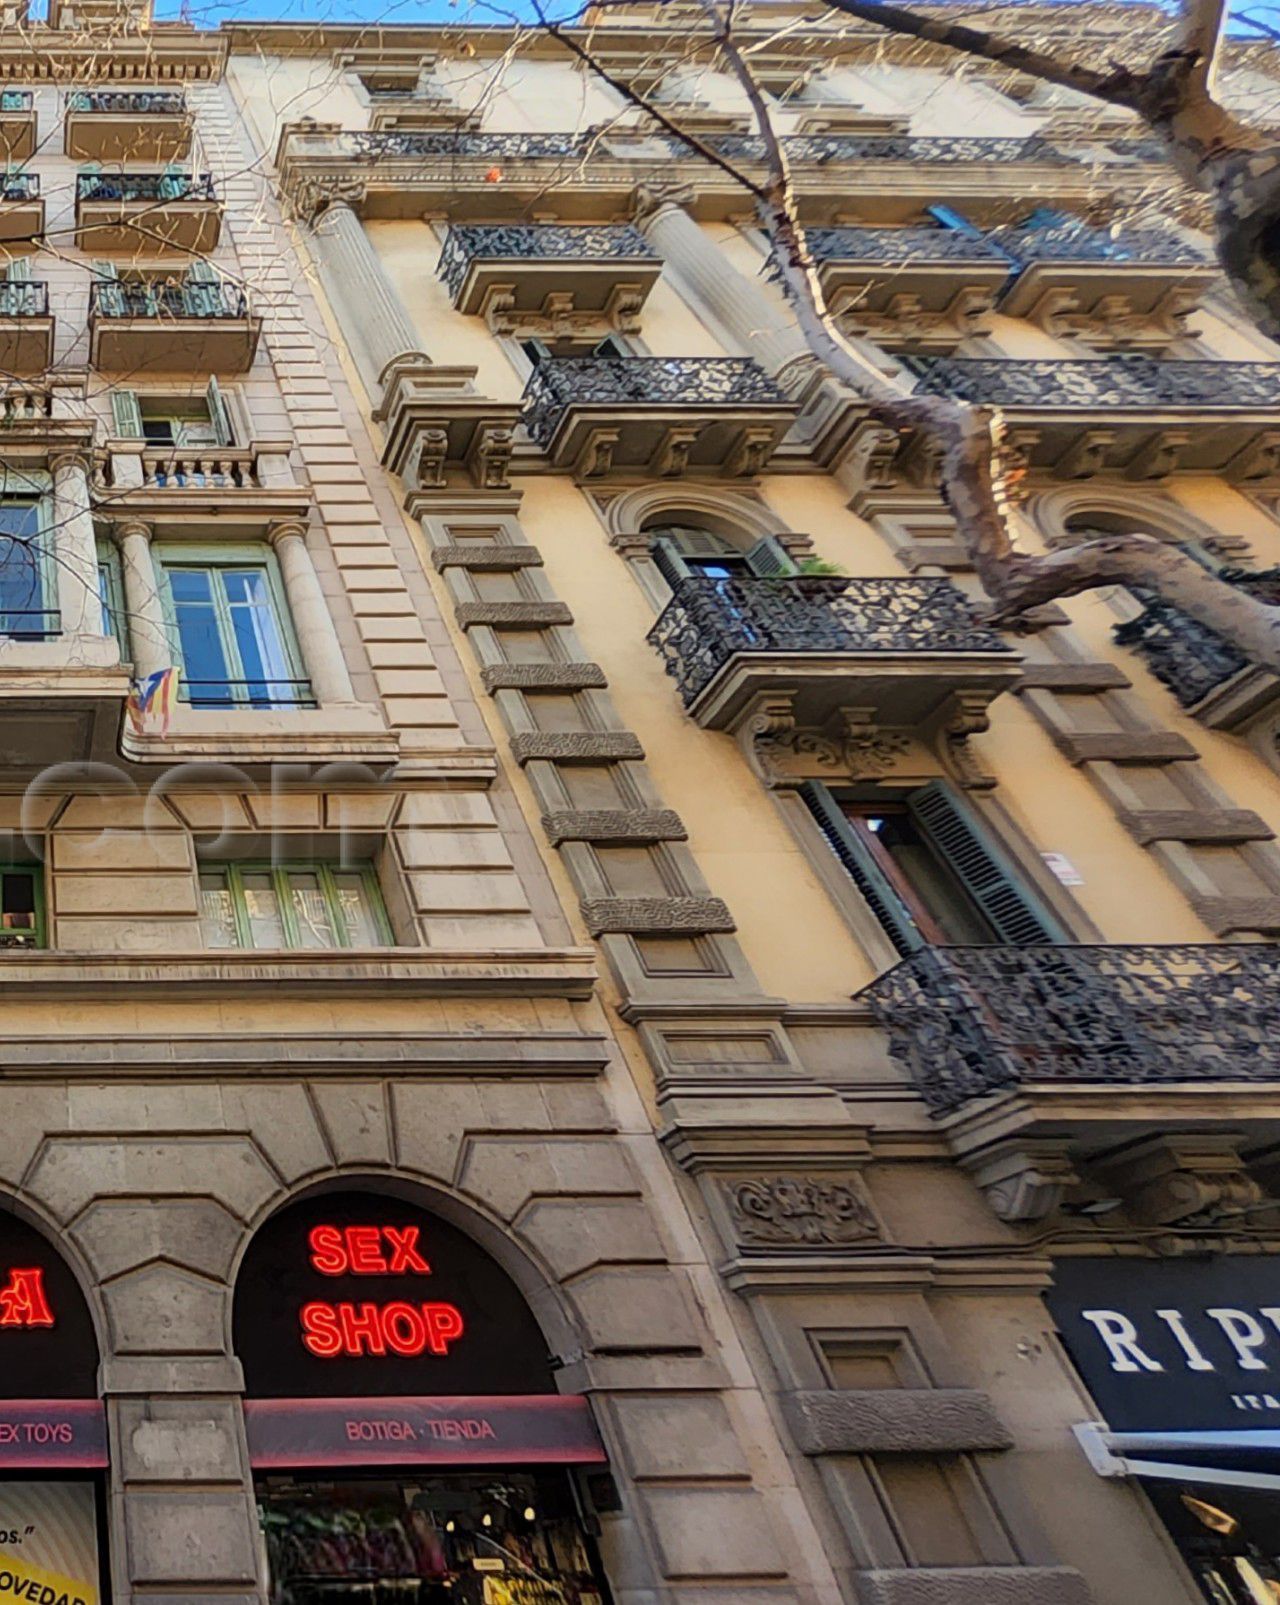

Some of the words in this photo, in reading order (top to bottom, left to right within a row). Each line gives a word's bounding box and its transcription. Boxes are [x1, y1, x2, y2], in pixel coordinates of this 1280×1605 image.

[308, 1225, 431, 1277] SEX
[301, 1302, 464, 1358] SHOP
[1082, 1308, 1280, 1372] RIP
[23, 1423, 73, 1443] TOYS
[345, 1421, 417, 1441] BOTIGA
[426, 1419, 497, 1440] TIENDA
